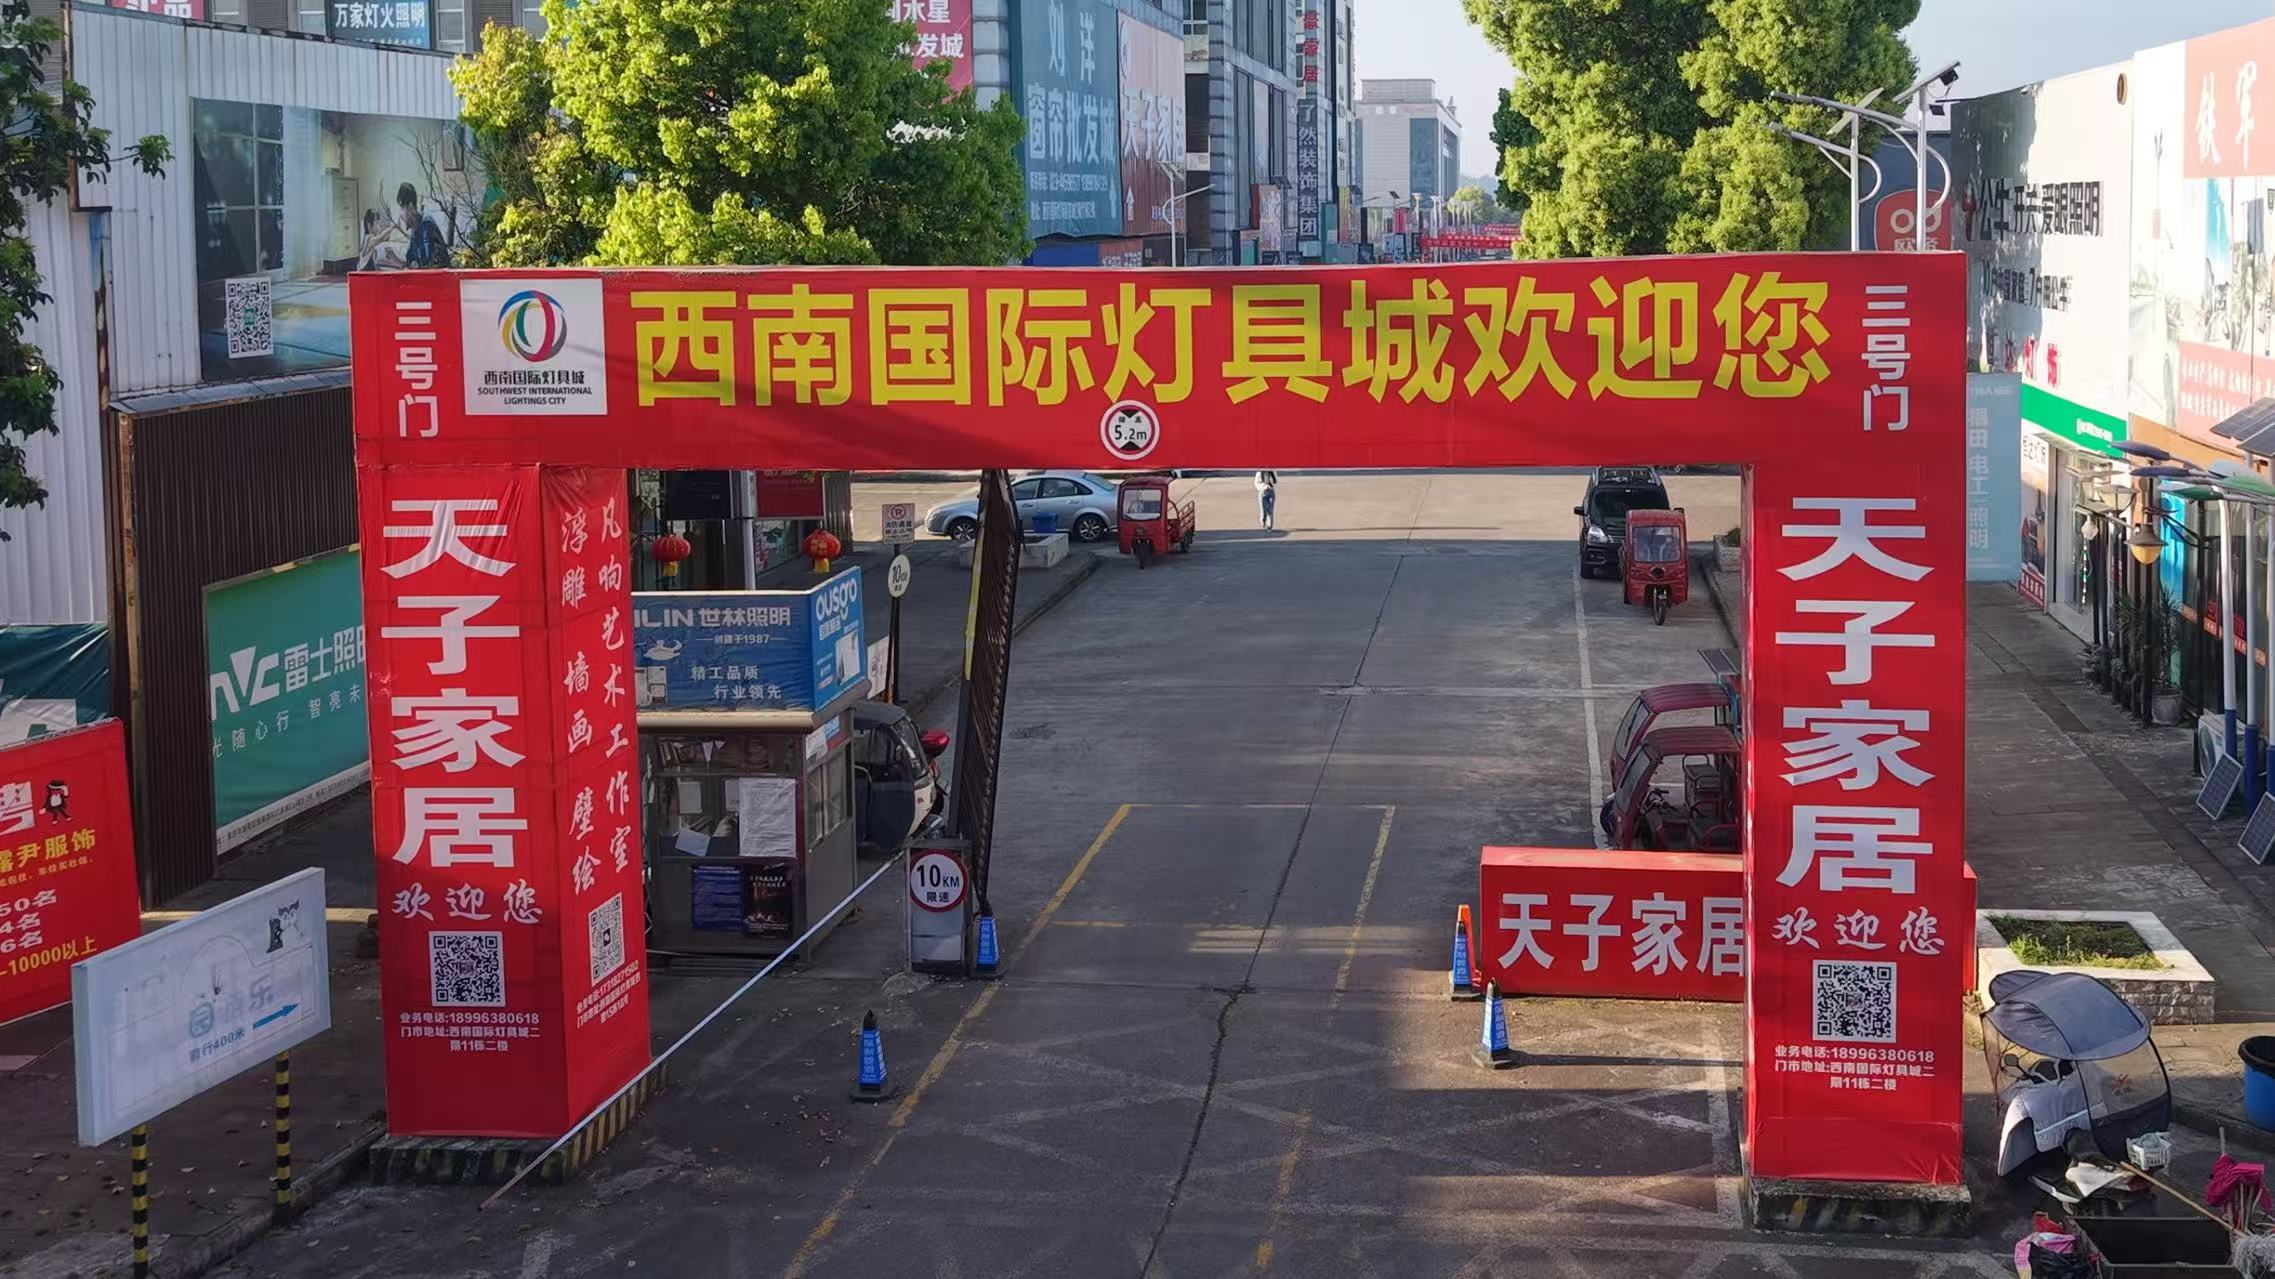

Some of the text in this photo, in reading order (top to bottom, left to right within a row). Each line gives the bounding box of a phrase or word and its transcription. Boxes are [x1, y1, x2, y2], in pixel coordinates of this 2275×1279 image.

[335, 2, 425, 28] 万家灯火照明
[1048, 0, 1095, 84] 刘洋
[1299, 104, 1318, 236] 了然装饰集团
[630, 271, 1830, 407] 西南国际灯具城欢迎您
[1862, 284, 1912, 433] 三号门
[394, 300, 439, 438] 三号门
[478, 387, 592, 396] SOUTHWEST INTERNATIONAL
[485, 370, 585, 386] 西南国际灯具城
[504, 396, 567, 406] LIGHTINGS CITY
[1114, 424, 1147, 440] 5.2m
[562, 506, 588, 609] 浮雕
[700, 607, 791, 627] 世林照明
[380, 499, 528, 868] 天子家居
[691, 665, 759, 680] 精工品质
[714, 684, 781, 699] 行业领先
[1775, 497, 1937, 893] 天子家居
[392, 878, 543, 924] 欢迎您
[926, 891, 950, 903] 限速
[1498, 892, 1743, 977] 天子家居
[1772, 906, 1945, 955] 欢迎您
